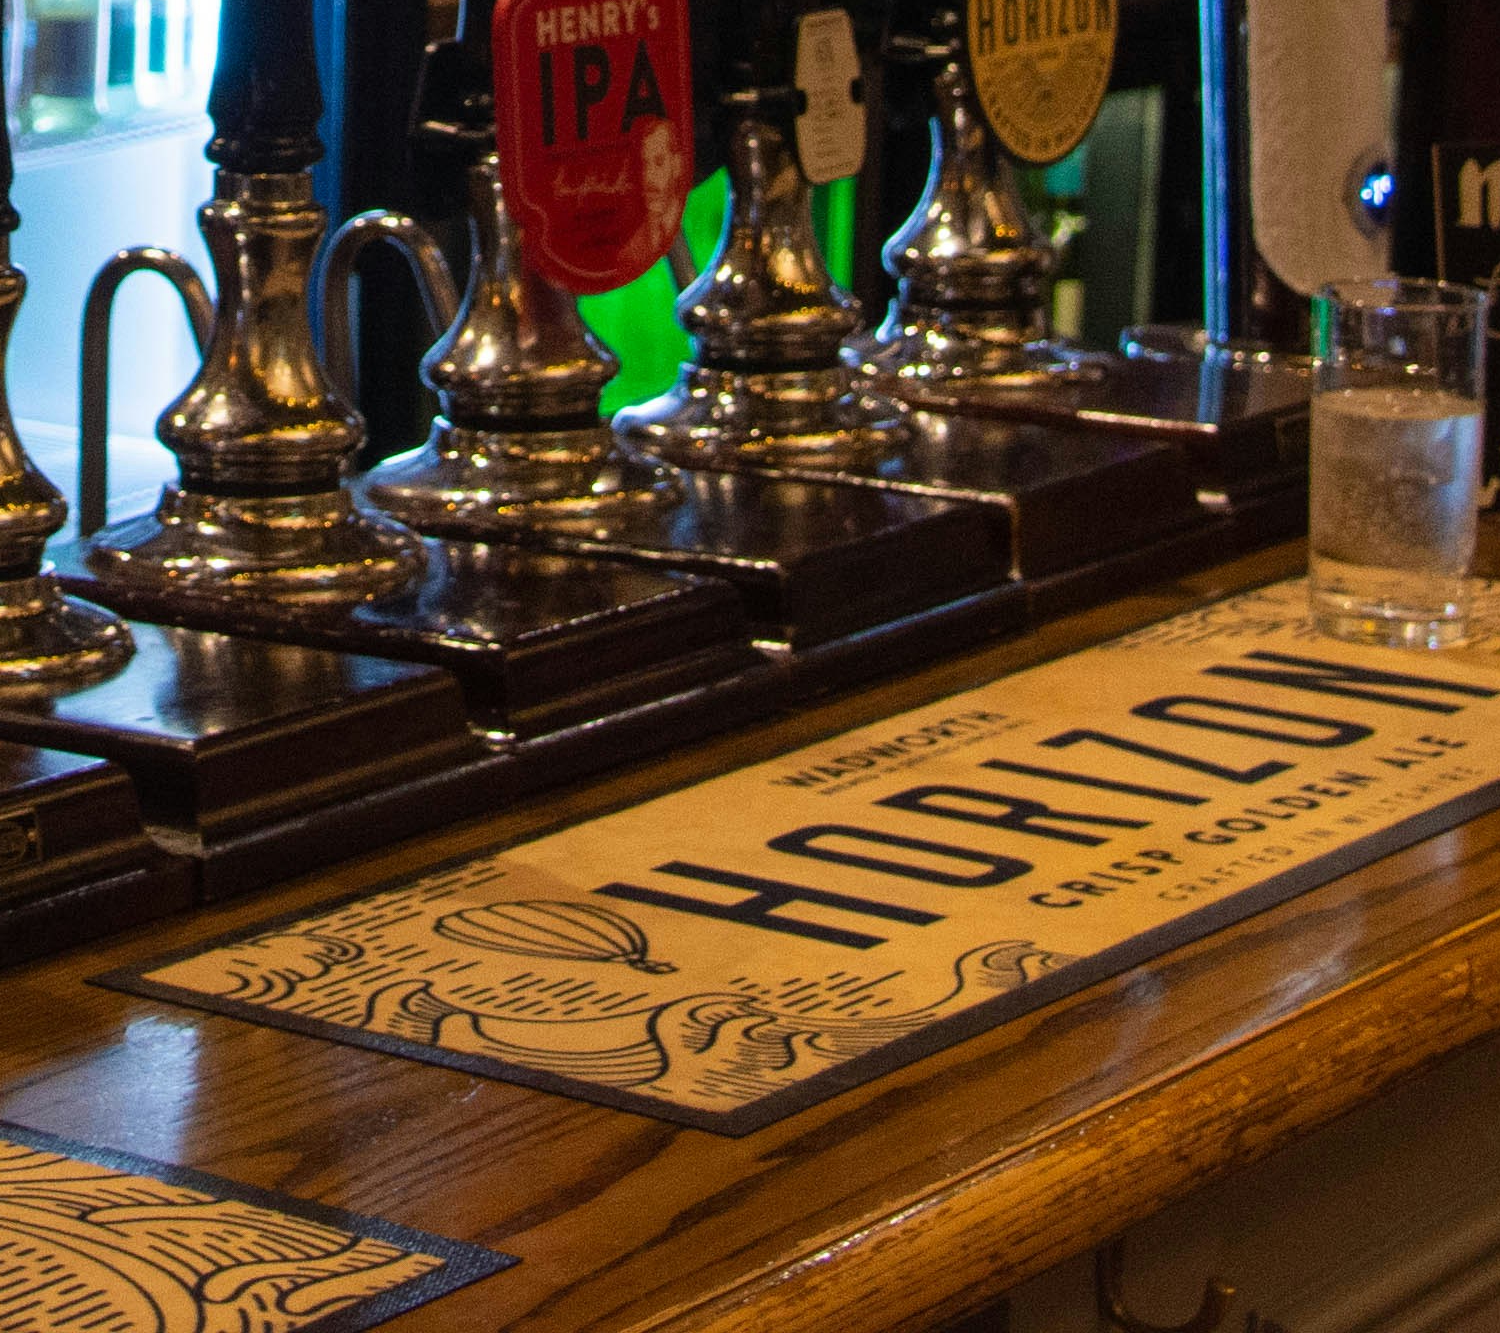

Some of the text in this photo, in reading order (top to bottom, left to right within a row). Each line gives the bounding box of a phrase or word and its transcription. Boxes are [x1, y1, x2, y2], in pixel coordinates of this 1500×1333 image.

[539, 37, 668, 146] IPA
[773, 709, 1010, 790] WADWORTH
[1027, 732, 1470, 911] CRISP GOLDEN ALE
[1156, 841, 1296, 905] CRAFTED
